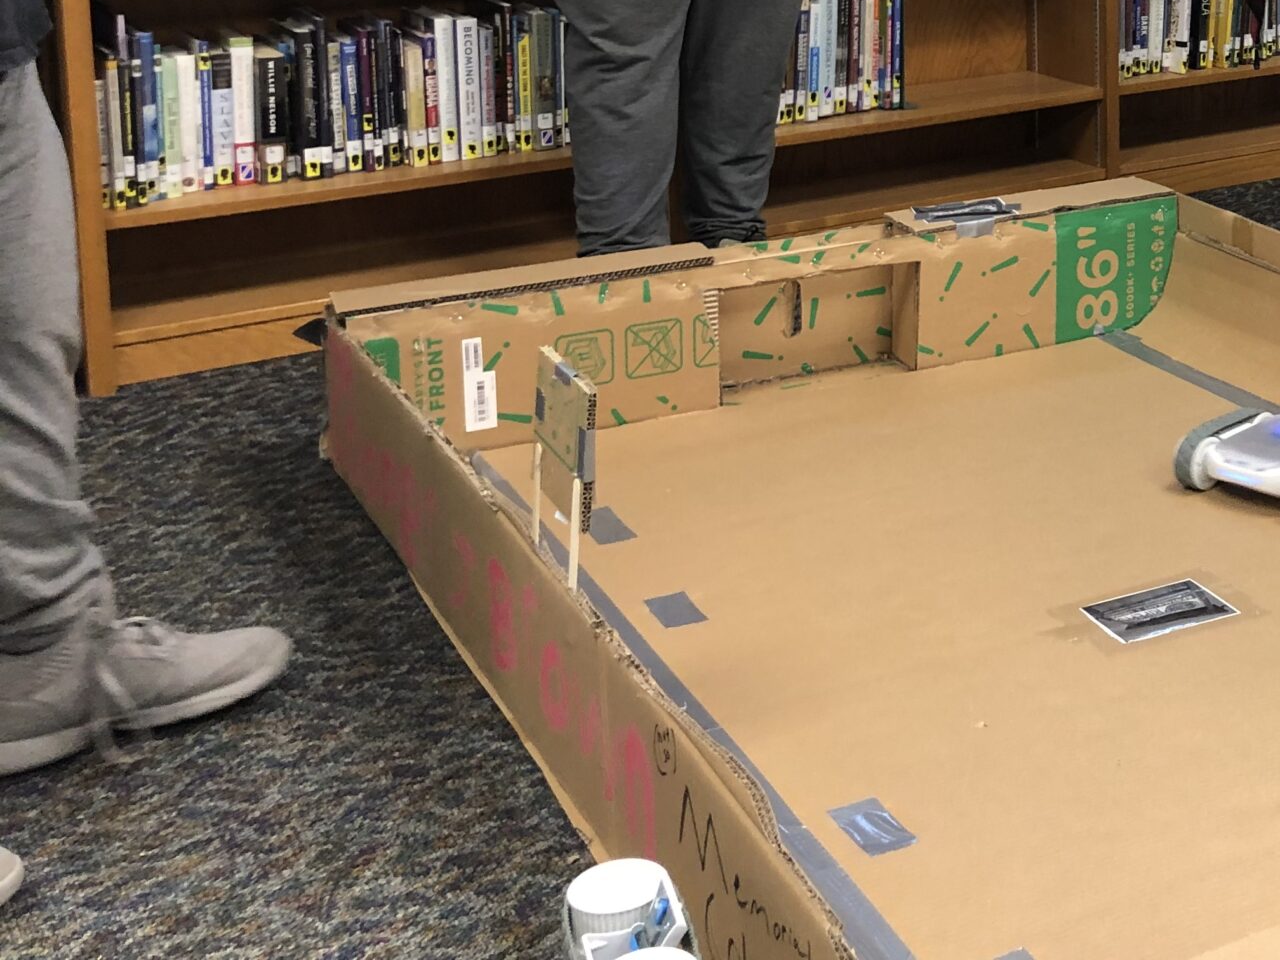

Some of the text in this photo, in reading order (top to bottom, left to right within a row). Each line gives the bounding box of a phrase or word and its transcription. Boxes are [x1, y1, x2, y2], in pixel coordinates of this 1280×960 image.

[463, 26, 474, 86] BECOMING
[267, 60, 277, 134] WILLIE NELSON
[1126, 223, 1136, 267] SERIES
[427, 338, 445, 412] FRONT
